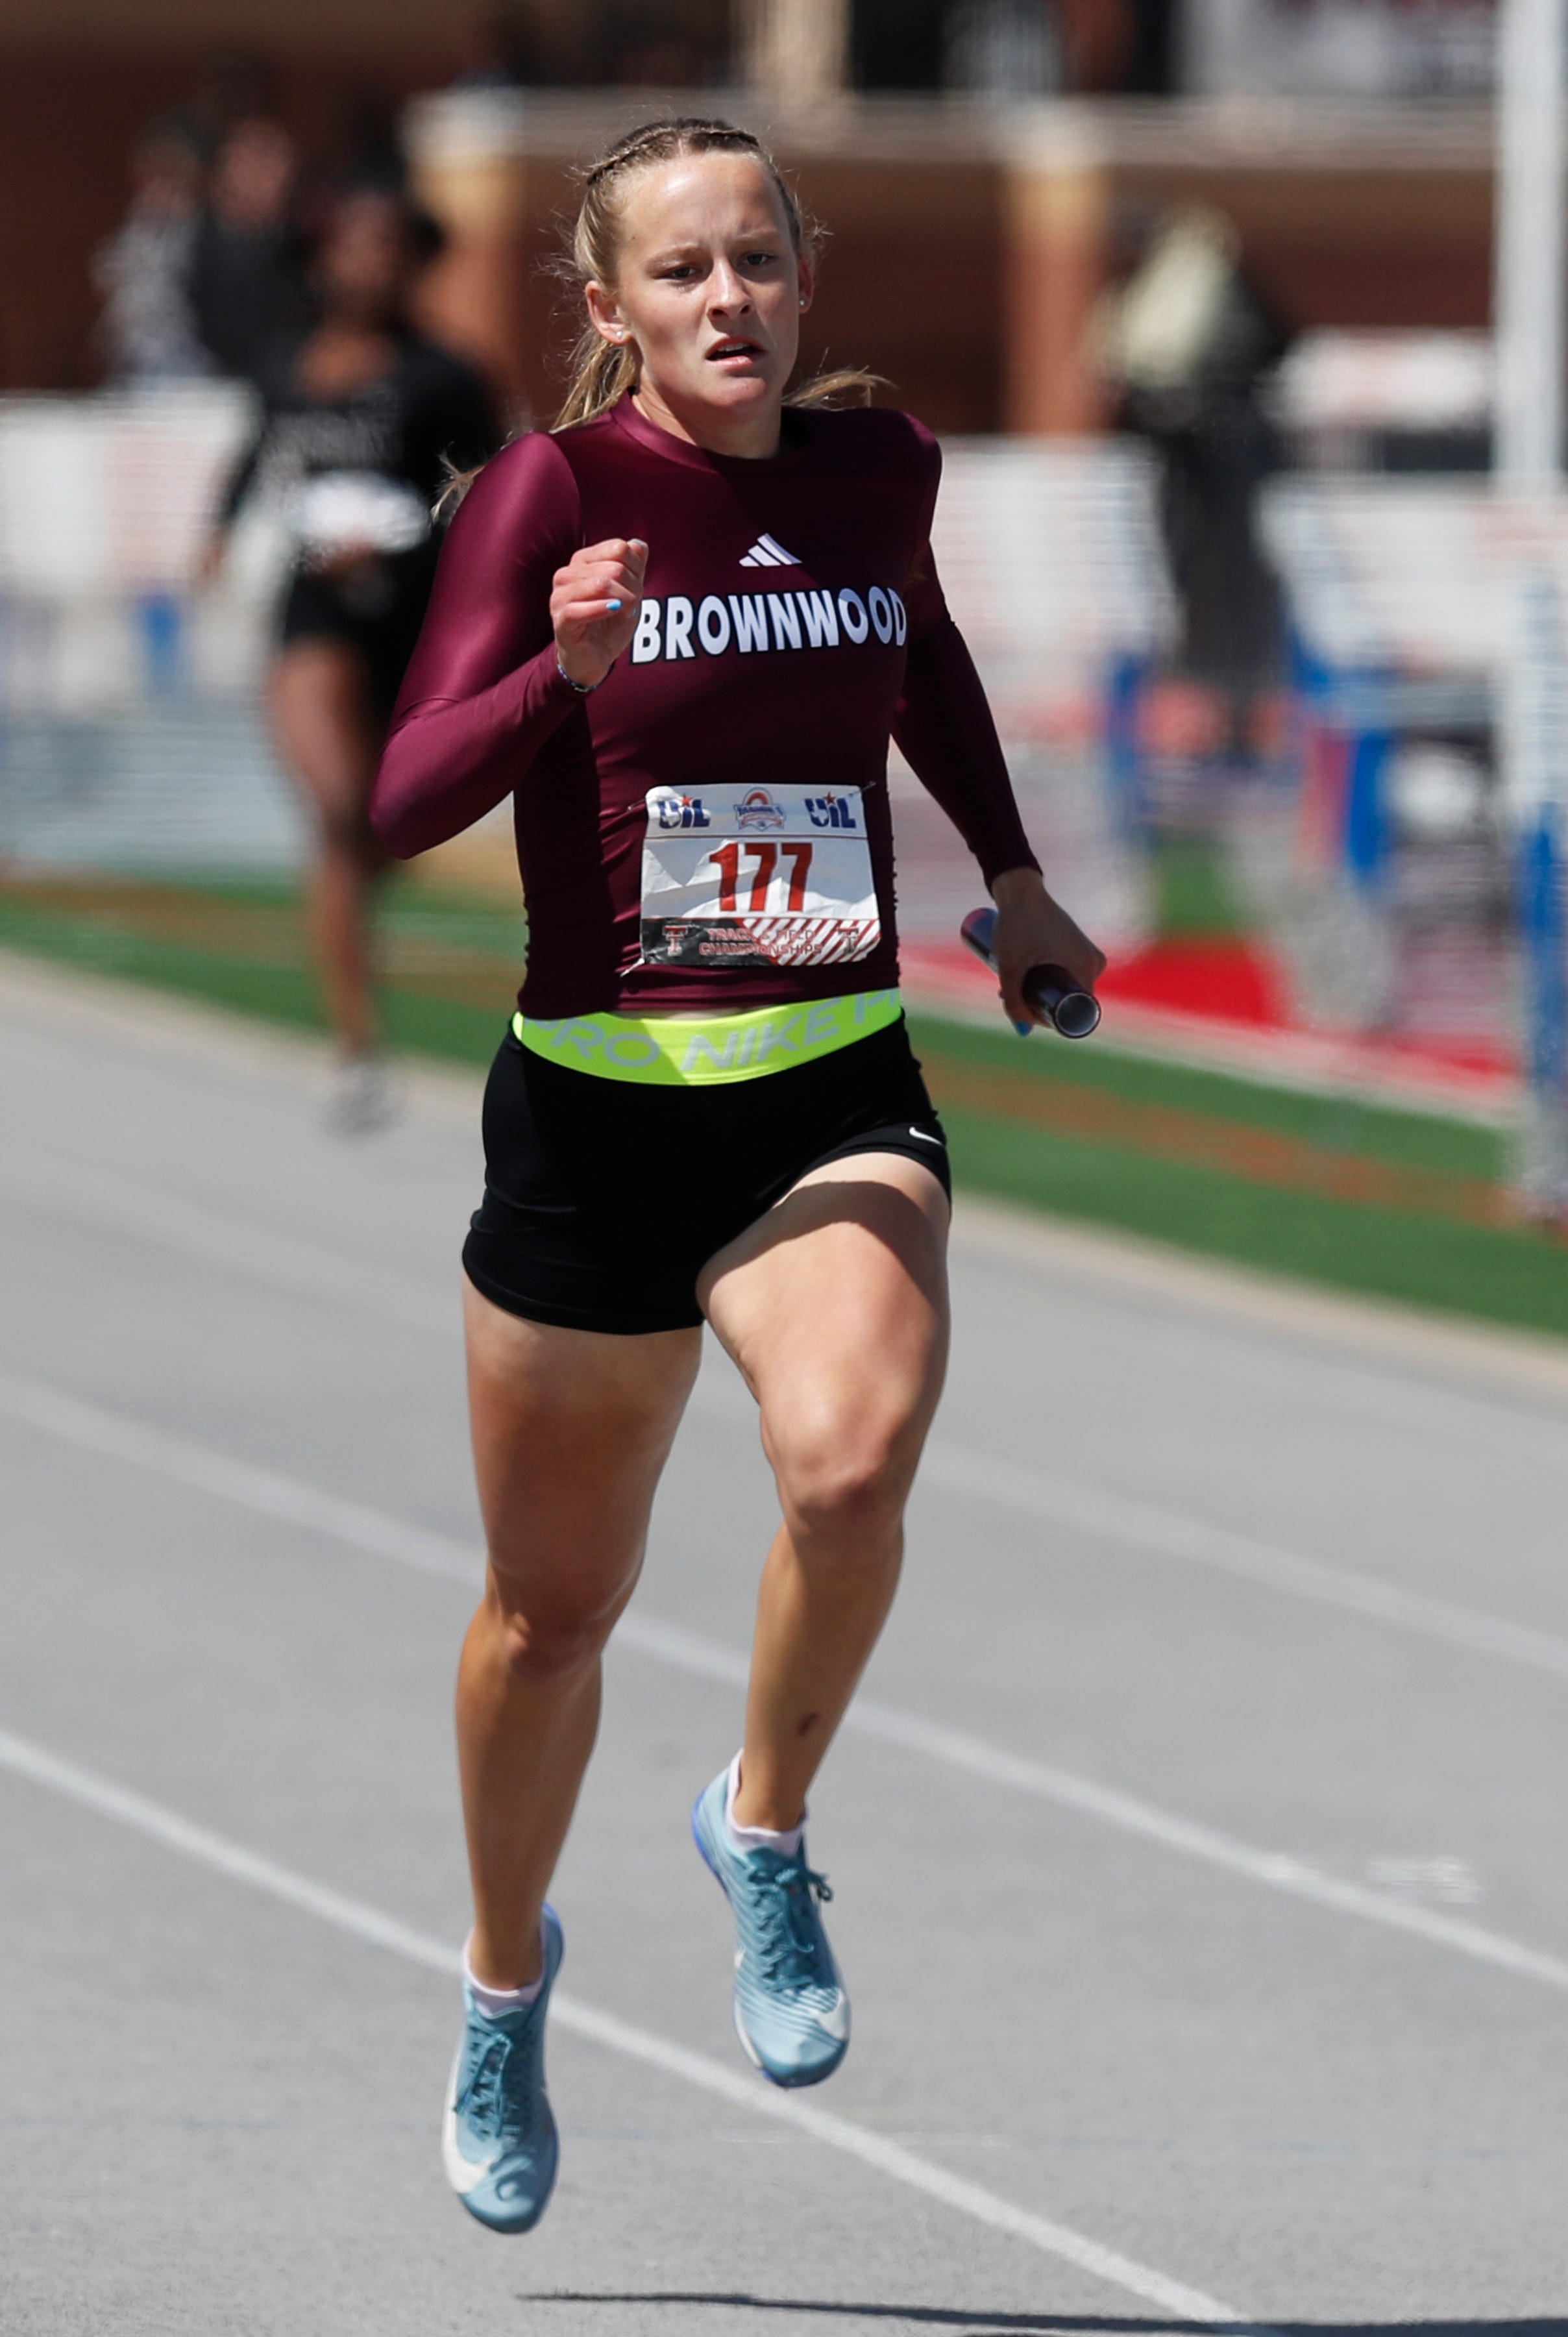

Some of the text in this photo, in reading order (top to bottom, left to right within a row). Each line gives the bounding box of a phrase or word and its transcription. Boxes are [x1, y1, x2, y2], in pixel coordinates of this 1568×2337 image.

[631, 585, 907, 663] BROWNWOOD
[709, 842, 813, 912] 177
[679, 996, 842, 1072] NIKE
